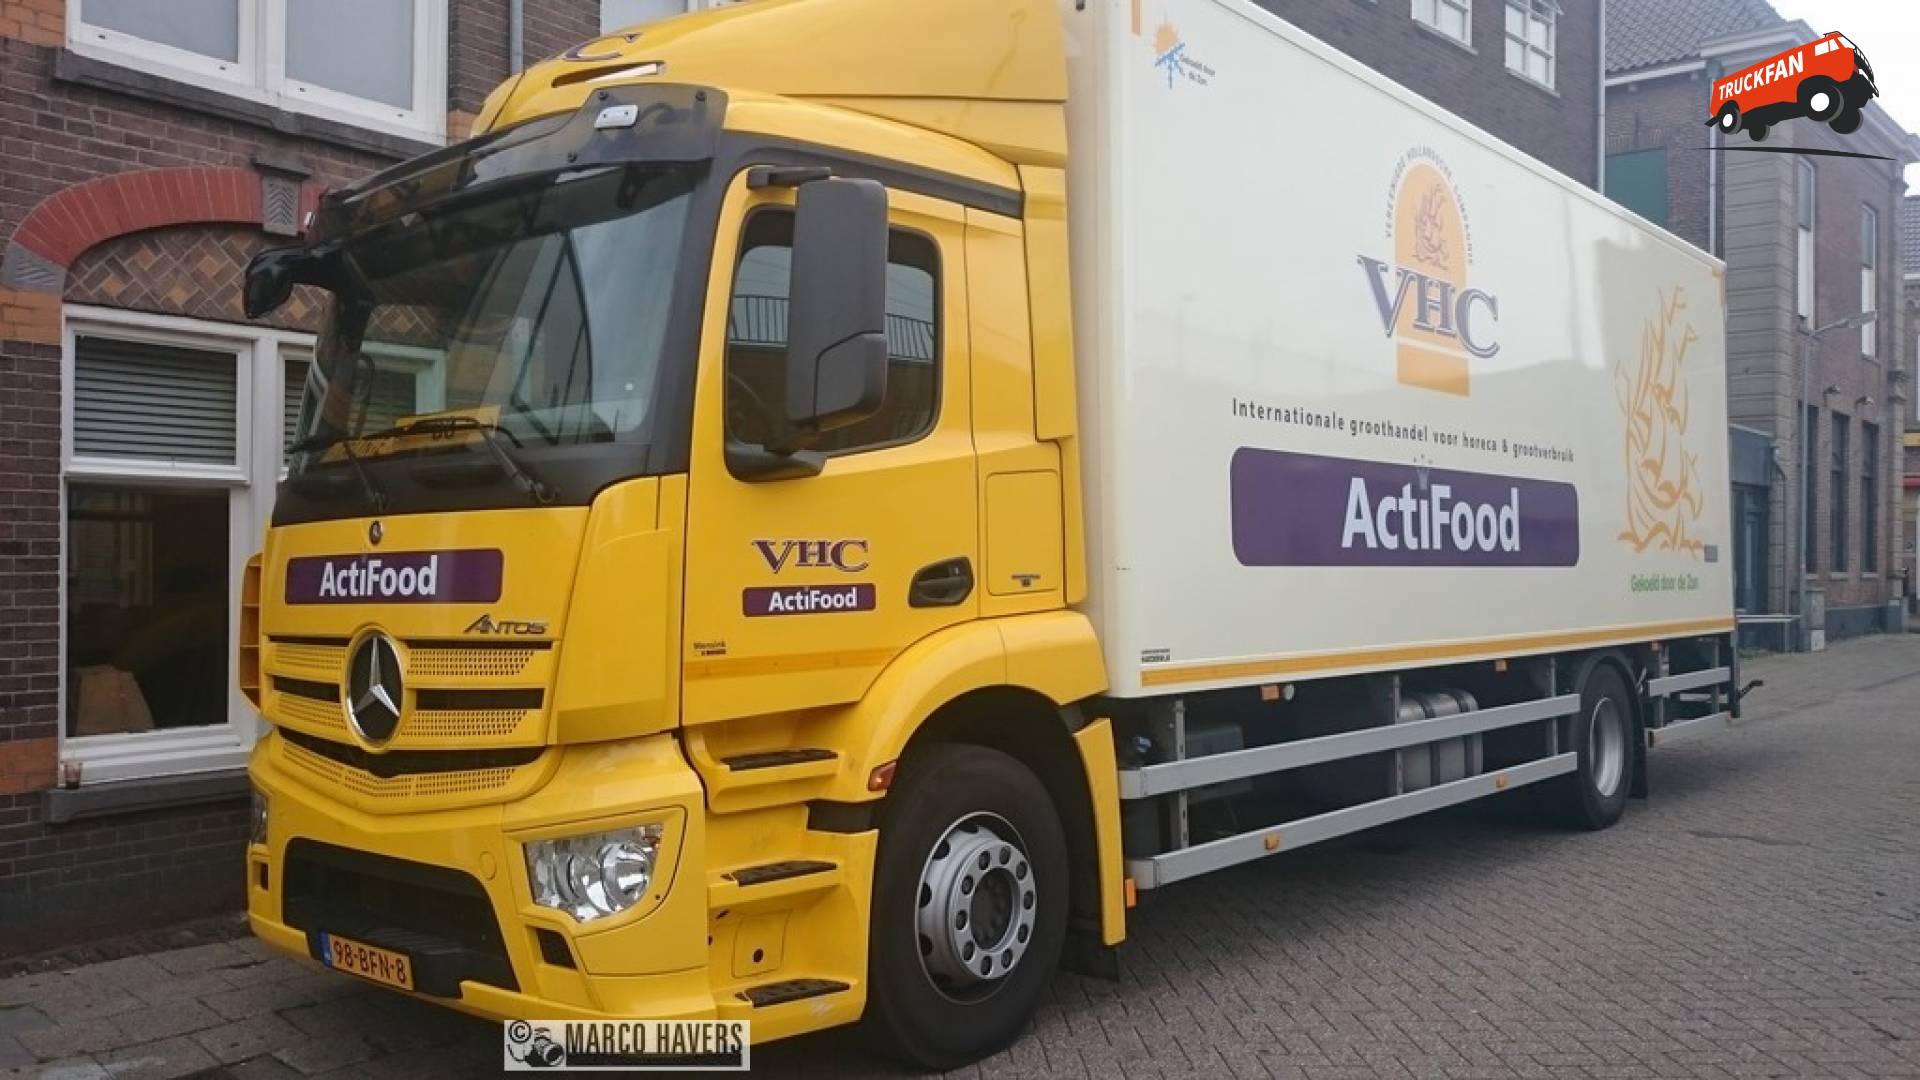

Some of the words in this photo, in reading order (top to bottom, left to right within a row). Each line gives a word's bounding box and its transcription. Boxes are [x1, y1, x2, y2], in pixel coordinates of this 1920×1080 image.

[1356, 254, 1500, 358] VHC
[1232, 397, 1346, 431] Internationale
[1350, 418, 1429, 443] groothandel
[1432, 430, 1458, 447] voor
[1461, 431, 1498, 452] horeca
[1501, 438, 1509, 453] &
[1512, 441, 1575, 463] grootverbruik
[1341, 476, 1522, 552] ActiFood
[318, 554, 439, 598] ActiFood
[751, 539, 870, 574] VHC
[768, 586, 858, 612] ActiFood
[463, 613, 550, 634] ANTOS
[332, 940, 407, 984] 98-BFN-8
